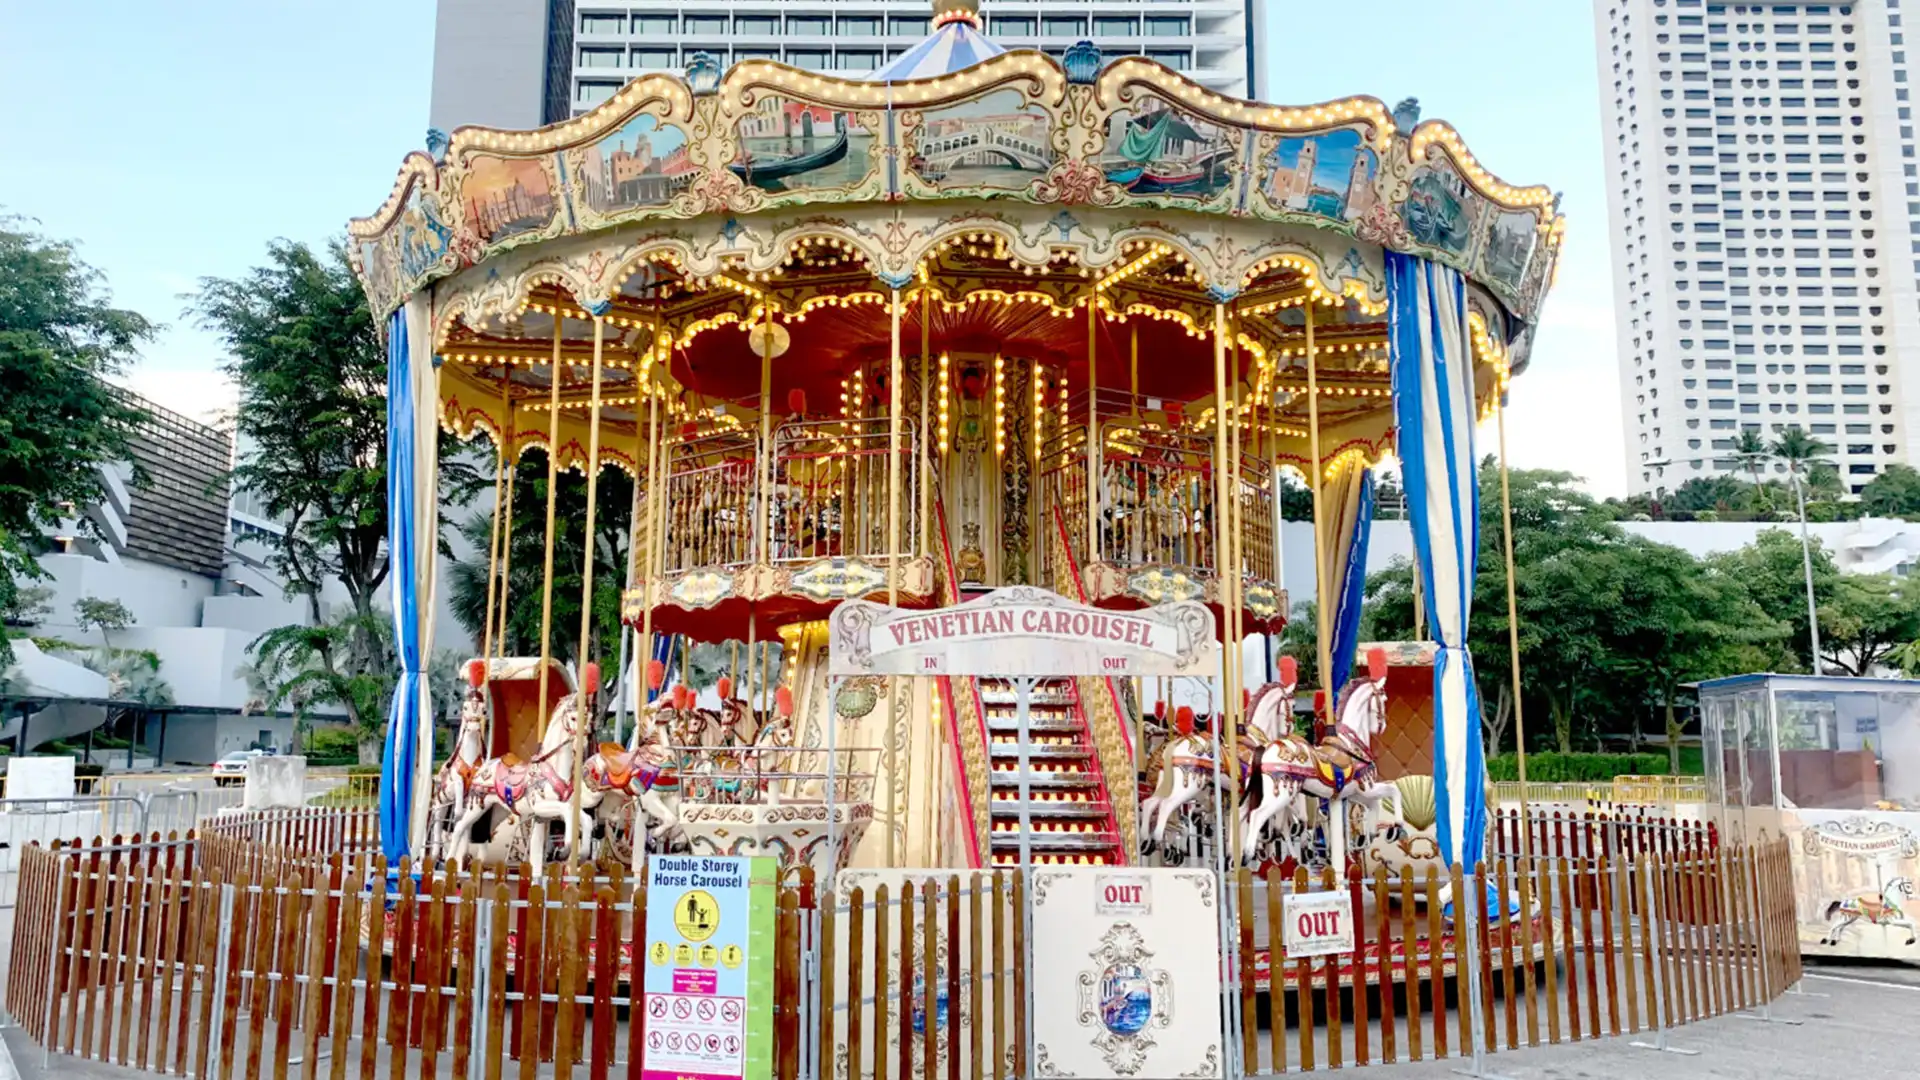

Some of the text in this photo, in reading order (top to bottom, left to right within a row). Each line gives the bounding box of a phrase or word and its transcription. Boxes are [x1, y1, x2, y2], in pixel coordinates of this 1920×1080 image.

[889, 610, 1154, 648] VENETIAN CAROUSEL
[924, 657, 938, 669] IN
[1103, 657, 1128, 670] OUT
[659, 858, 739, 875] Double Storey
[654, 873, 687, 886] Horse
[691, 873, 742, 888] Carousel
[1105, 885, 1143, 903] OUT
[1298, 910, 1340, 938] OUT
